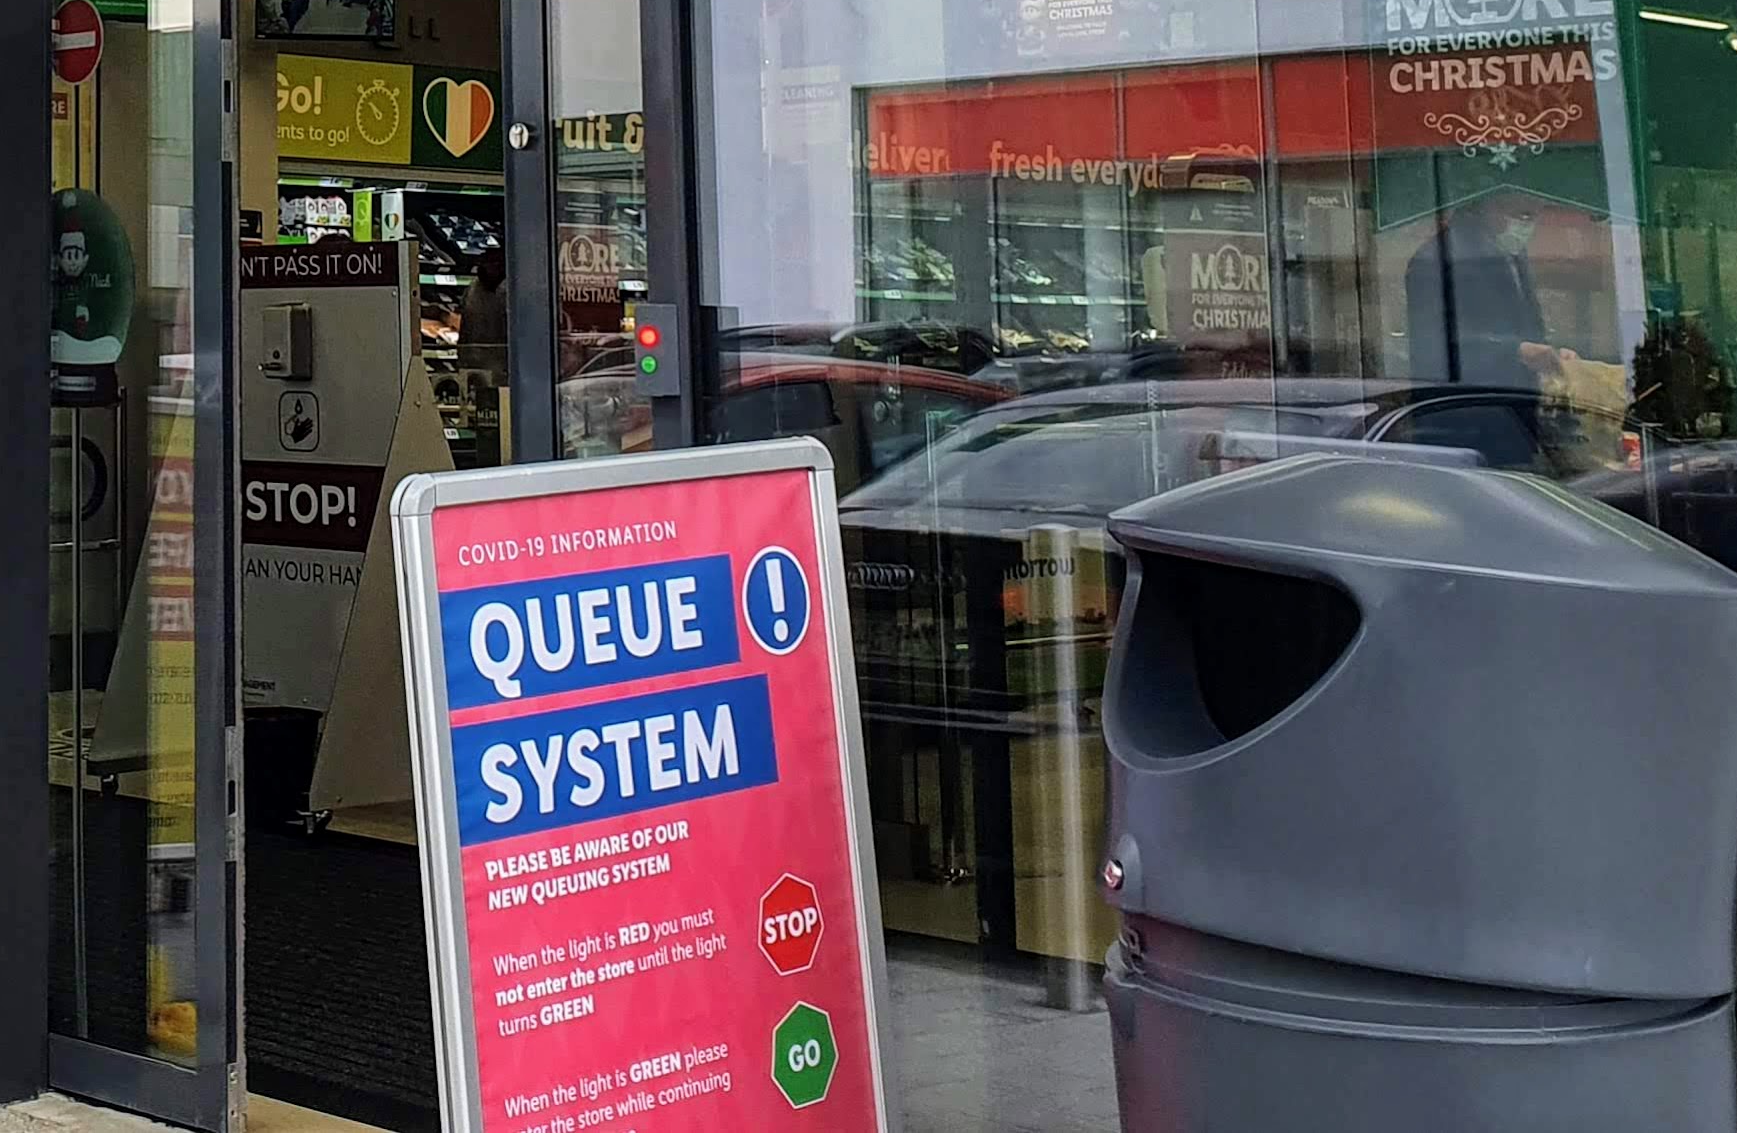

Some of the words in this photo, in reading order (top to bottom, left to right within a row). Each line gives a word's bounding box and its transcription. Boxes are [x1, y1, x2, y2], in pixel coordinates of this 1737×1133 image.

[1049, 5, 1113, 20] CHRISTMAS
[1388, 35, 1432, 57] FOR
[1436, 27, 1556, 53] EVERYONE
[1560, 21, 1616, 44] THIS
[277, 71, 323, 116] Go!
[1389, 48, 1617, 94] CHRISTMAS
[309, 126, 325, 141] to
[328, 126, 351, 148] go!
[624, 112, 645, 154] &
[990, 140, 1063, 183] fresh
[241, 256, 269, 277] N'T
[274, 254, 322, 277] PASS
[326, 254, 343, 275] IT
[347, 252, 382, 276] ON!
[245, 480, 357, 528] STOP!
[457, 536, 546, 568] COVID-19
[550, 521, 678, 556] INFORMATION
[275, 560, 324, 584] YOUR
[468, 575, 704, 699] QUEUE
[479, 703, 740, 825] SYSTEM
[485, 850, 549, 882] PLEASE
[550, 843, 573, 865] BE
[574, 833, 631, 863] AWARE
[631, 827, 654, 851] OF
[655, 820, 690, 845] OUR
[487, 882, 529, 913] NEW
[531, 866, 610, 906] QUEUING
[612, 852, 671, 885] SYSTEM
[492, 946, 538, 977] When
[542, 943, 566, 967] the
[568, 933, 603, 963] light
[605, 933, 617, 951] is
[618, 922, 651, 947] RED
[653, 918, 679, 945] you
[680, 908, 715, 931] must
[763, 906, 818, 945] STOP
[495, 981, 524, 1007] not
[526, 974, 568, 1000] enter
[570, 966, 596, 990] the
[597, 957, 635, 983] store
[637, 947, 670, 974] until
[671, 942, 694, 965] the
[695, 933, 728, 961] light
[498, 1012, 539, 1038] turns
[539, 994, 596, 1027] GREEN
[787, 1039, 823, 1074] GO
[504, 1092, 551, 1119] When
[551, 1082, 578, 1106] the
[578, 1074, 614, 1102] light
[614, 1070, 628, 1088] is
[629, 1052, 683, 1084] GREEN
[683, 1043, 729, 1071] please
[550, 1114, 576, 1133] the
[577, 1105, 615, 1131] store
[615, 1092, 657, 1118] while
[657, 1069, 733, 1106] continuing
